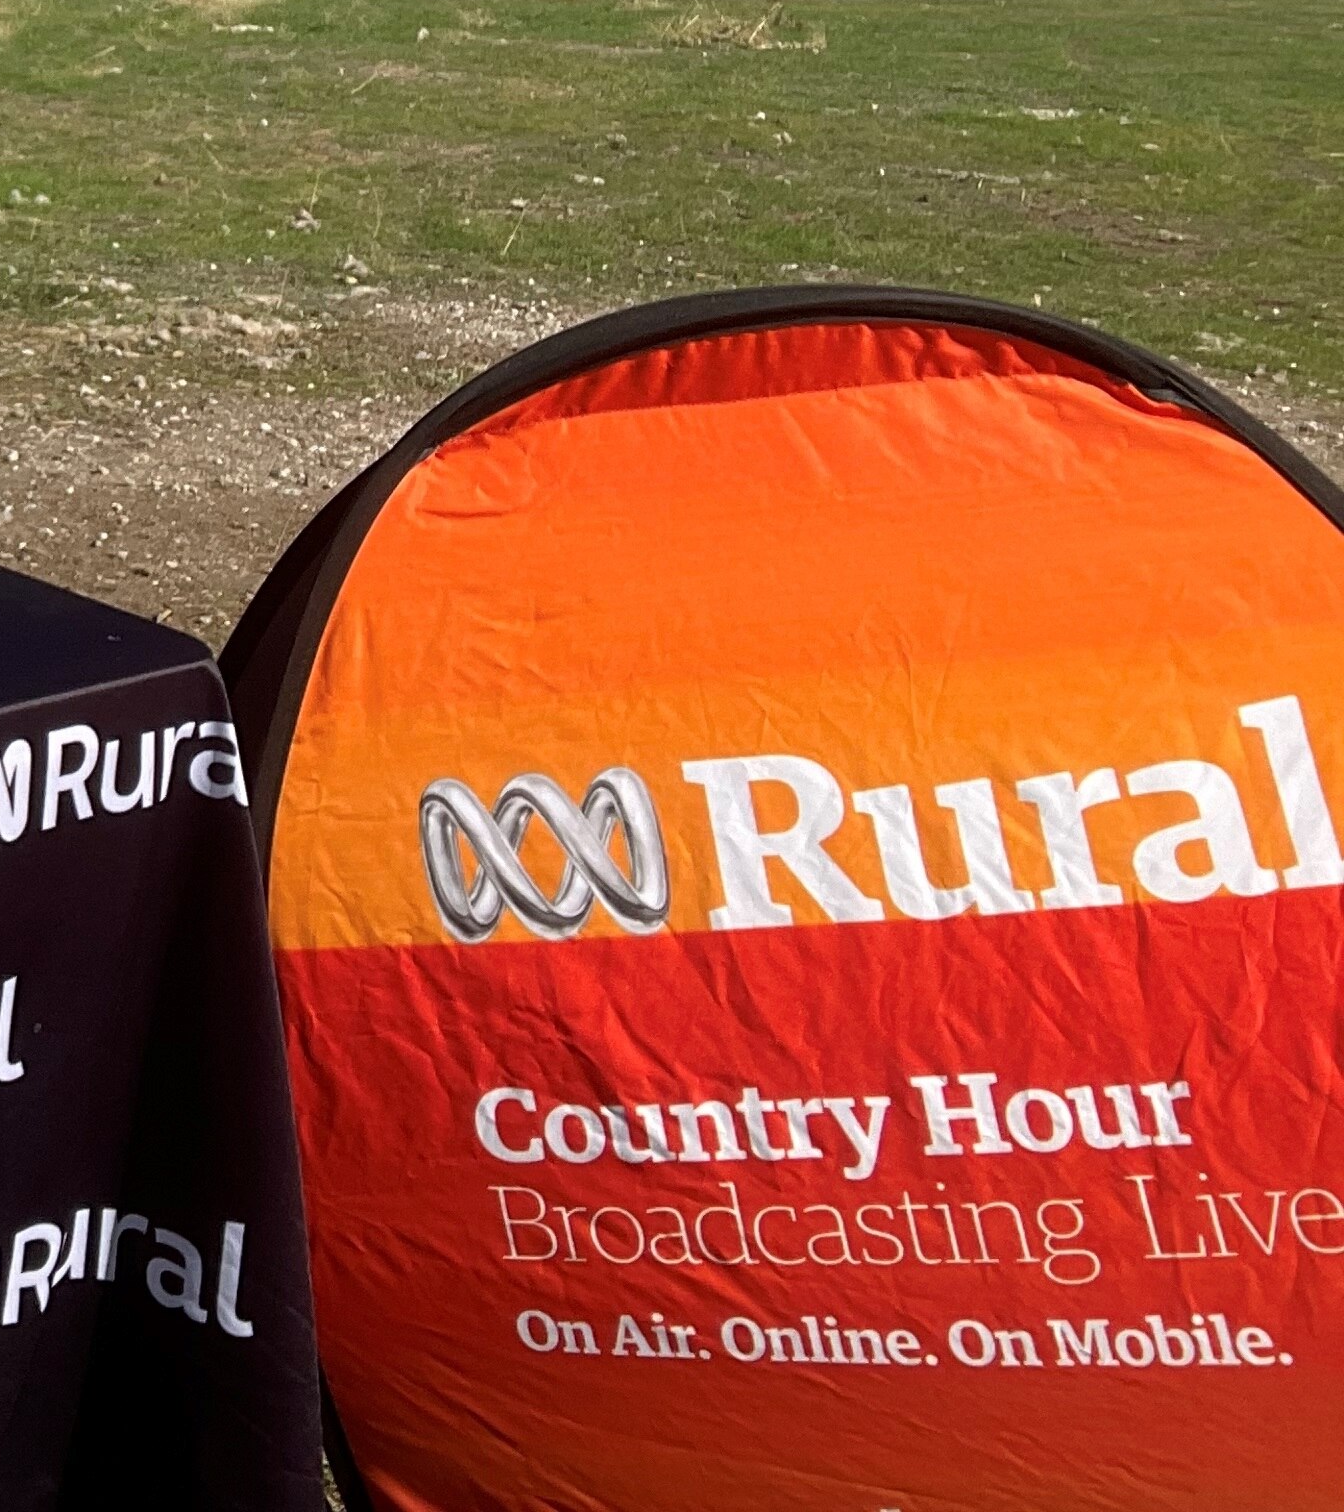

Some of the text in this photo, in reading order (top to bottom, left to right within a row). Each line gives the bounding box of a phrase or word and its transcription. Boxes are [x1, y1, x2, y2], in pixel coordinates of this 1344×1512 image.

[41, 720, 249, 831] Rura
[681, 694, 1344, 931] Rural
[474, 1071, 1192, 1182] Country Hour
[2, 1207, 254, 1339] Rural
[487, 1172, 1344, 1286] Broadcasting Live
[515, 1309, 1294, 1368] On Air. Online. On Mobile.
